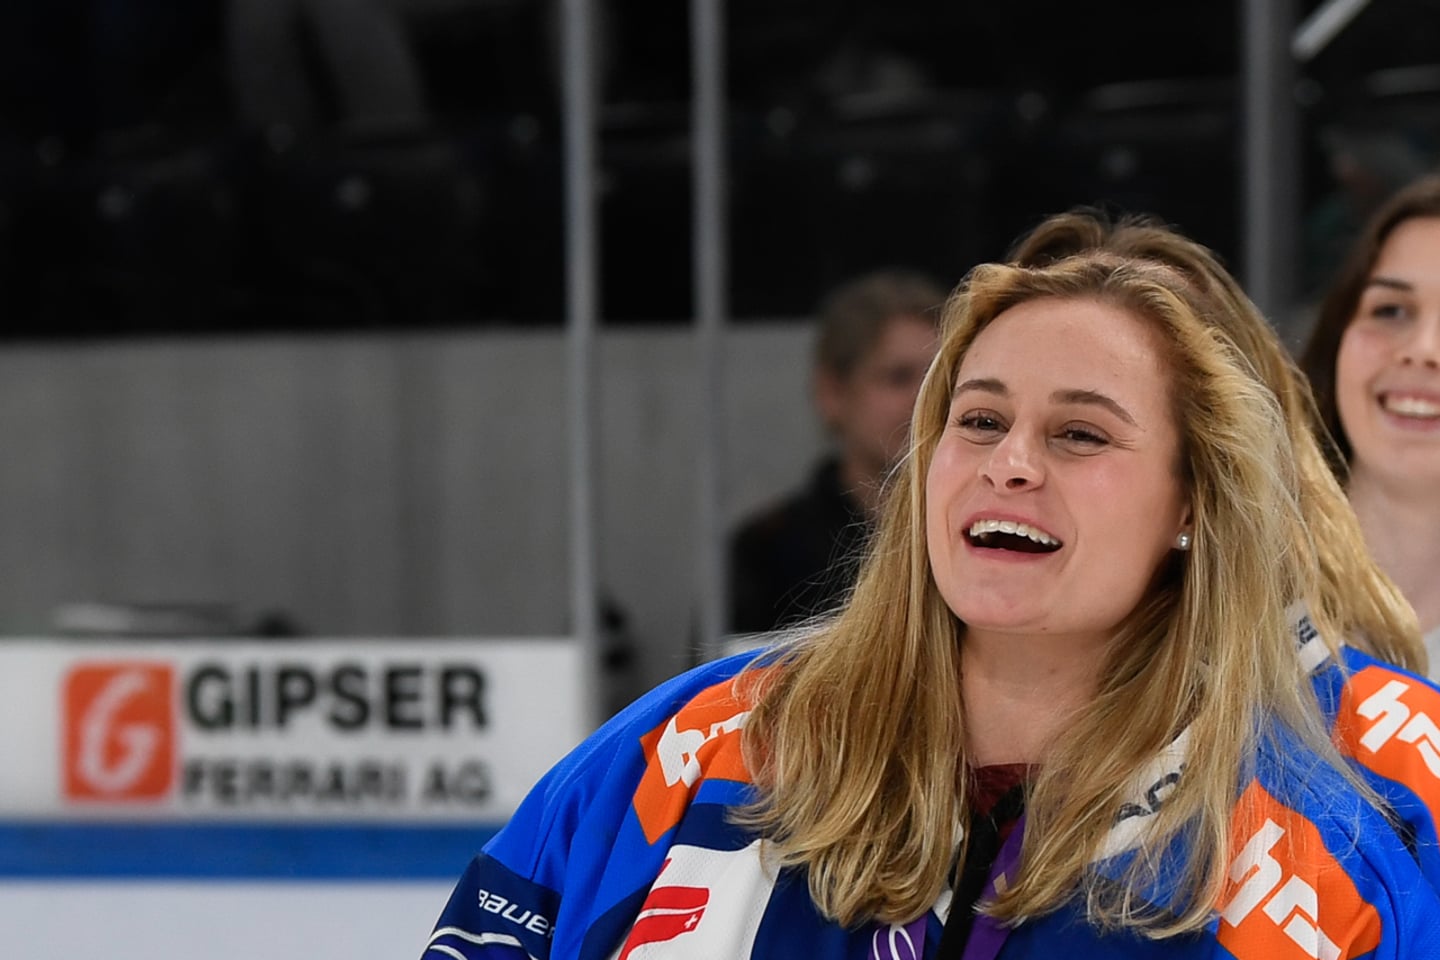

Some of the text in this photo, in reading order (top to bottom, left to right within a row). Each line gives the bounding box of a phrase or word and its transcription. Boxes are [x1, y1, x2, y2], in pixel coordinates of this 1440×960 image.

[186, 666, 490, 734] GIPSER
[183, 762, 492, 801] FERRARI AG
